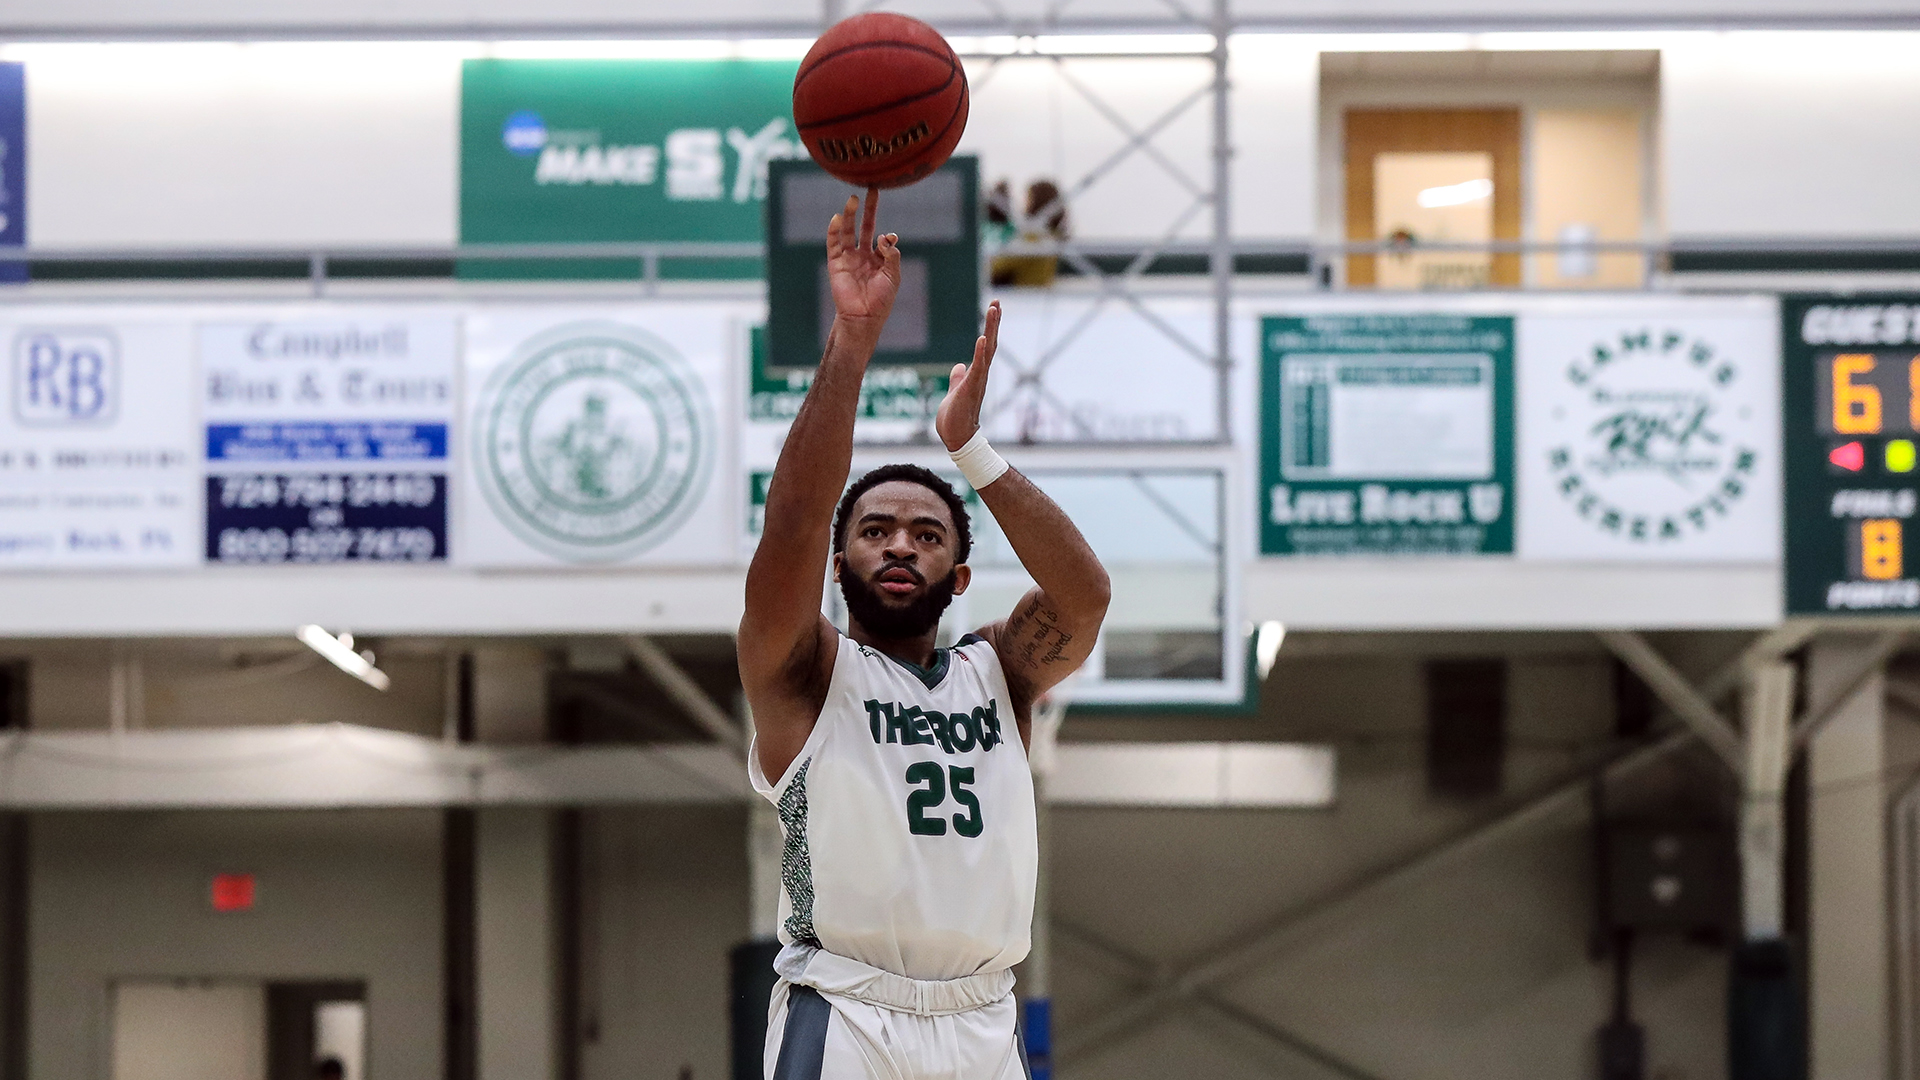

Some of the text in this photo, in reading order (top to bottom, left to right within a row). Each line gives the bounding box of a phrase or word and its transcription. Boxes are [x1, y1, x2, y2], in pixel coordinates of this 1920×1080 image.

[817, 120, 931, 163] Wilson
[245, 320, 409, 363] Campbell
[1567, 331, 1736, 388] CAMPUS
[341, 367, 448, 406] Tours
[1467, 482, 1504, 524] U
[1546, 446, 1757, 542] RECREATION
[1861, 518, 1903, 580] 8
[905, 761, 984, 838] 25
